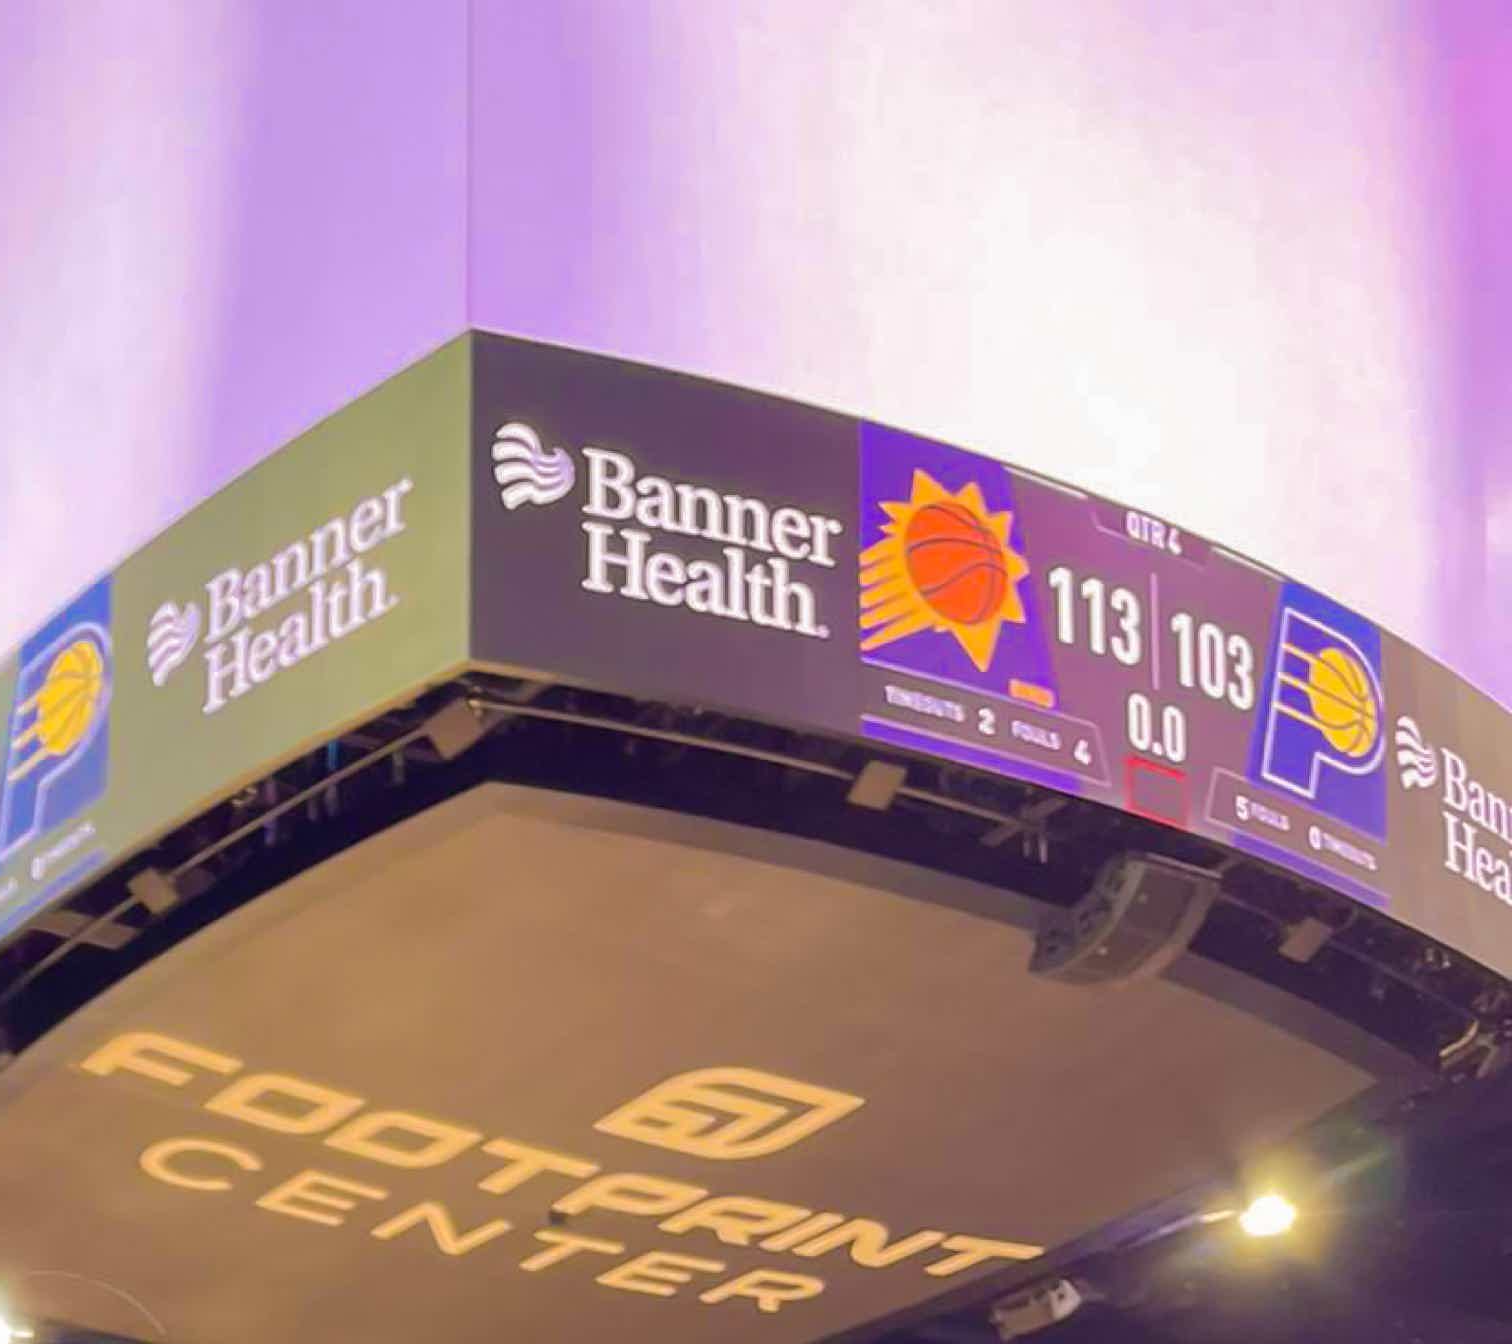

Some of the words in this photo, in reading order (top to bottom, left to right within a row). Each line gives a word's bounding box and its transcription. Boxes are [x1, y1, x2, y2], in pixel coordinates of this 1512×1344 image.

[202, 475, 415, 644] Banner
[582, 446, 843, 568] Banner
[1048, 566, 1141, 665] 113
[1170, 612, 1255, 711] 103
[1127, 692, 1187, 763] 0.0
[1441, 811, 1512, 906] Hea
[78, 1030, 1044, 1277] FOOTPRINT
[138, 1137, 826, 1313] CENTER
